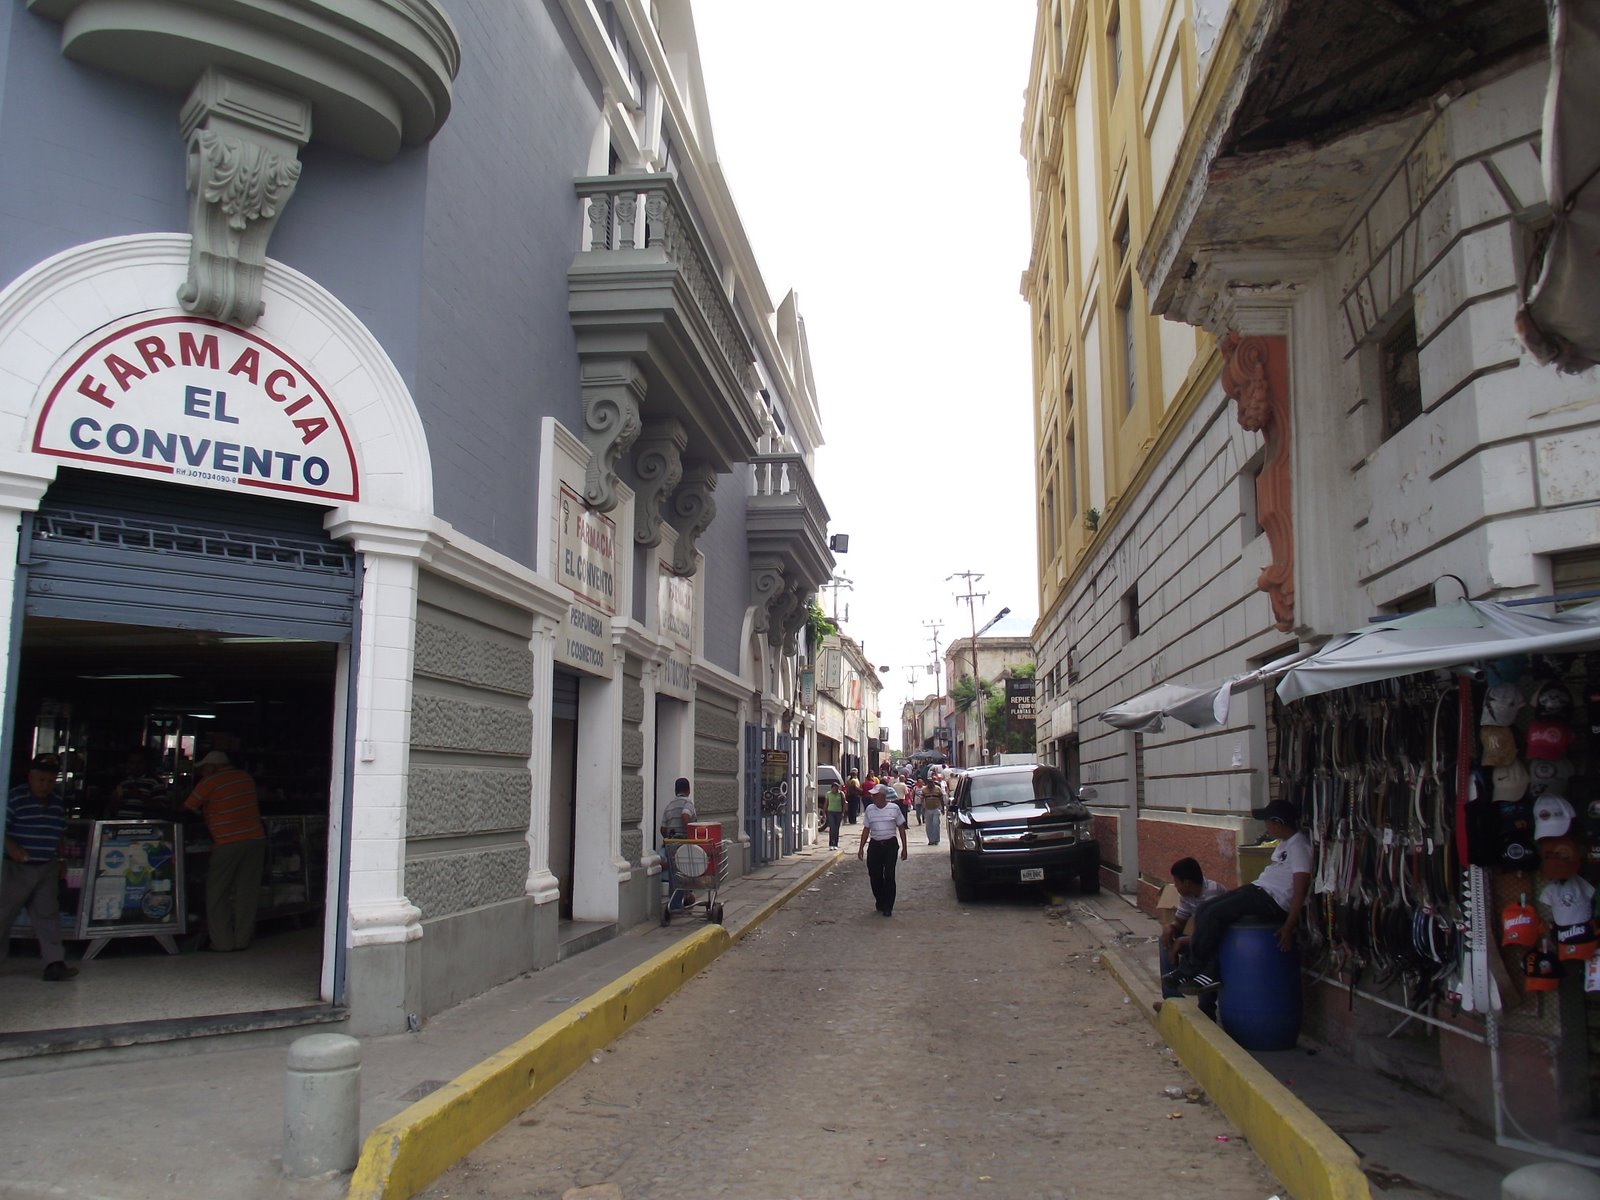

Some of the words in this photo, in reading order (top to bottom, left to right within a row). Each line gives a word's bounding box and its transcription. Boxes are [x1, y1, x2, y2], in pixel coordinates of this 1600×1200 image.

[77, 331, 329, 445] FARMACIA
[184, 385, 240, 425] EL
[69, 417, 330, 486] CONVENTO
[576, 515, 613, 560] FARMACIA
[565, 548, 575, 577] EL
[577, 555, 613, 597] CONVENTO
[570, 607, 603, 638] PERFUMERIA
[566, 637, 571, 656] Y
[571, 640, 604, 667] COSMETICOS
